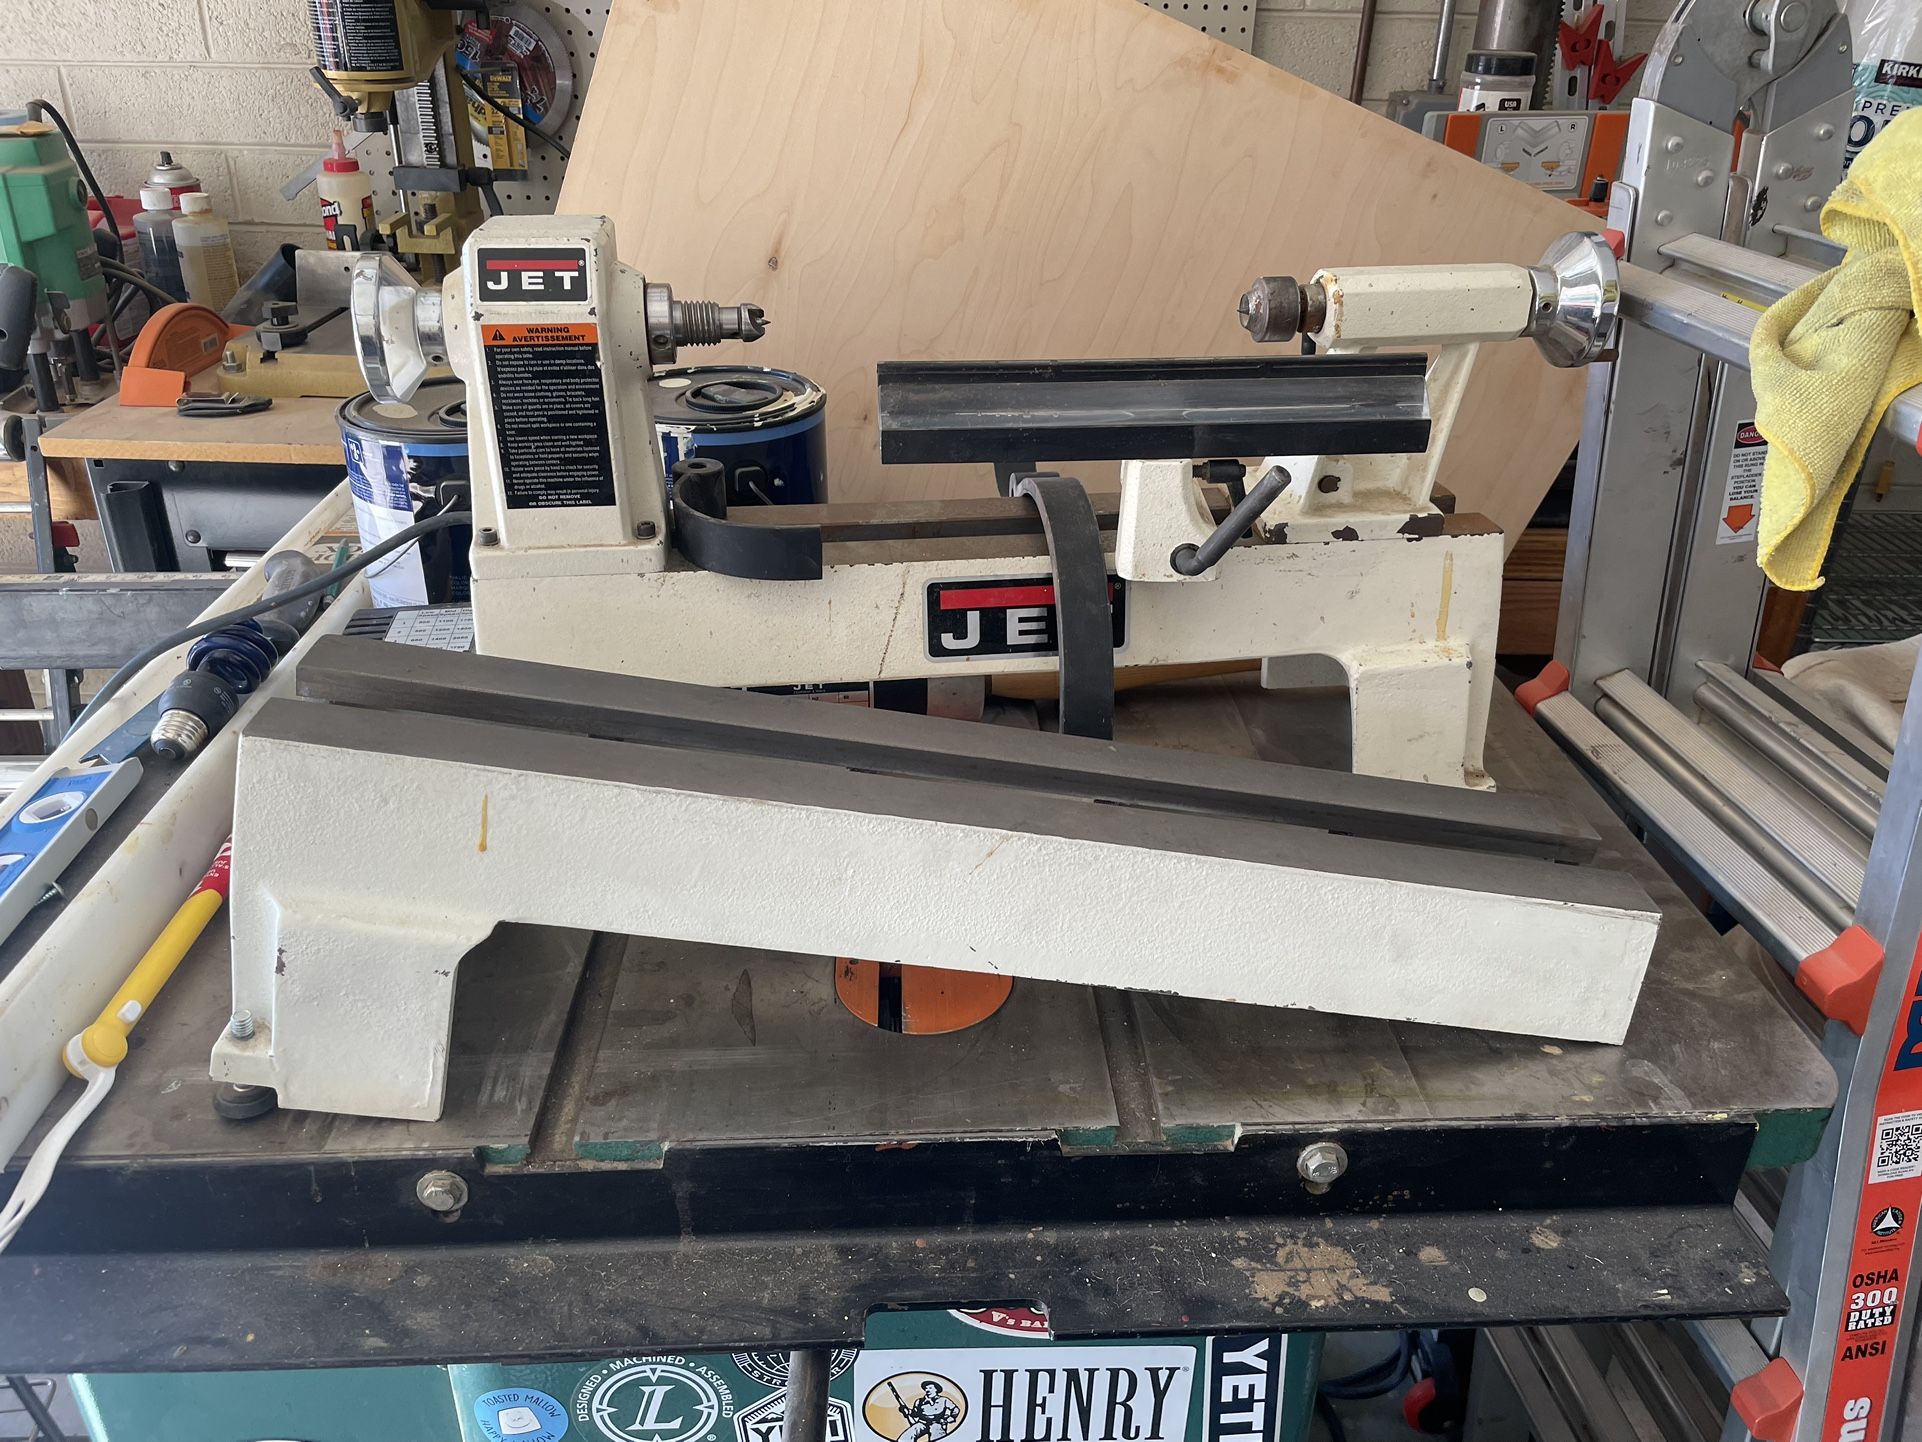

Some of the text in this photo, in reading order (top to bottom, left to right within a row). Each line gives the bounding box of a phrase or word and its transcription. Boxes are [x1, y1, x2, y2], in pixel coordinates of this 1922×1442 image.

[1861, 100, 1908, 116] PRE
[486, 271, 579, 291] JET
[512, 334, 586, 343] AVERTISSEMENT
[526, 326, 570, 334] WARNING
[1739, 431, 1760, 440] DANG
[940, 607, 1050, 650] JE
[1852, 1268, 1899, 1289] OSHA
[1850, 1287, 1898, 1311] 300
[1847, 1316, 1893, 1331] RATED
[1849, 1305, 1894, 1322] DUTY
[1841, 1340, 1887, 1362] ANSI
[609, 1355, 686, 1372] MACHINED
[576, 1373, 602, 1423] DESIGNED
[695, 1365, 734, 1418] ASSEMBLED
[1219, 1337, 1270, 1442] YETI
[482, 1393, 561, 1418] TOASTED MALLOW
[975, 1366, 1181, 1442] HENRY
